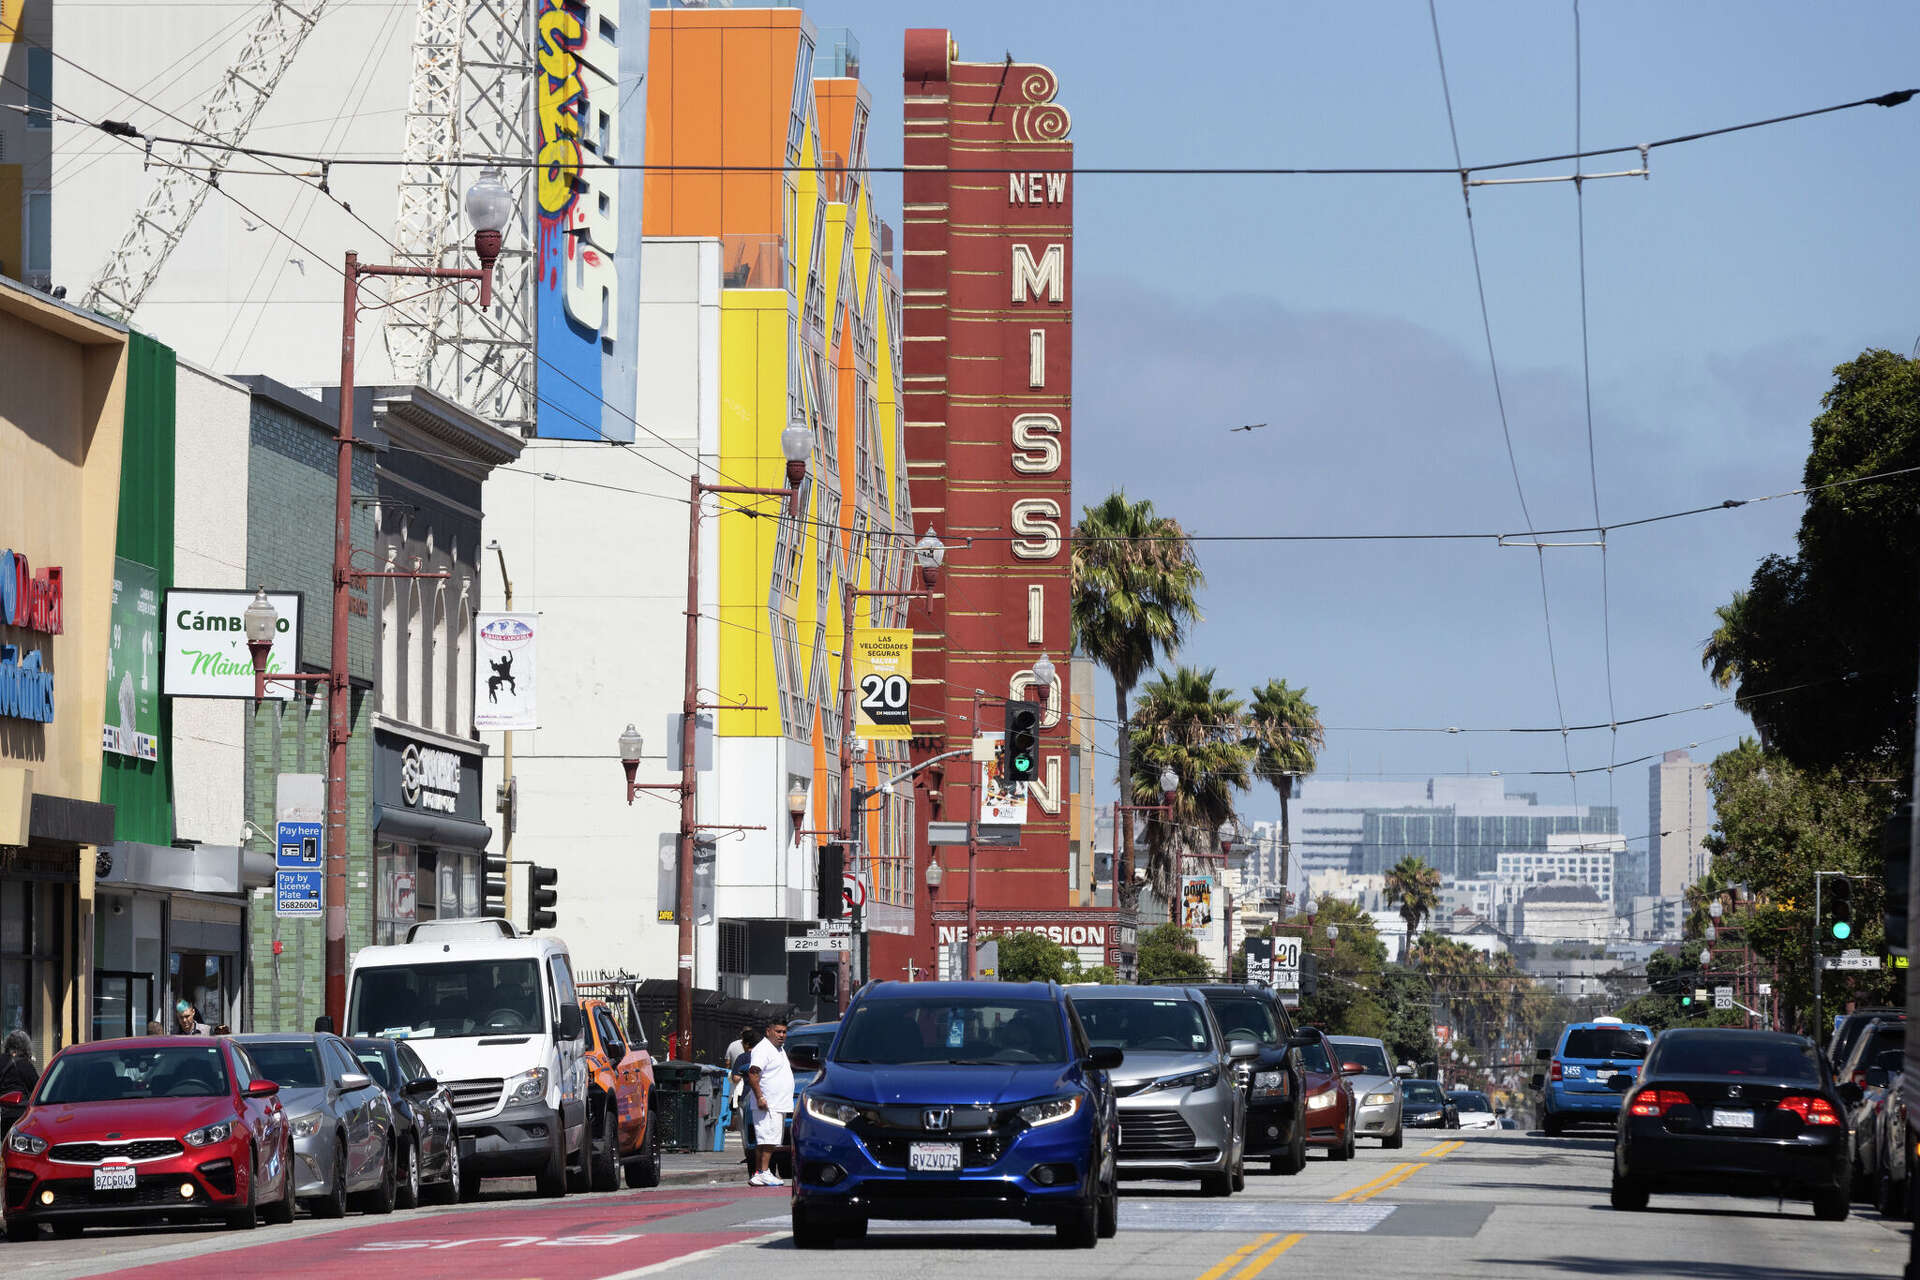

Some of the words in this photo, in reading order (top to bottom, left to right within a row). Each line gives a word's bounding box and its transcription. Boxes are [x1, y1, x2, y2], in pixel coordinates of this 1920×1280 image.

[1009, 172, 1067, 204] NEW
[1009, 243, 1065, 815] MISSION
[859, 642, 909, 650] VELOCIDADES
[181, 648, 282, 677] Mándlo
[861, 674, 908, 708] 20
[280, 826, 297, 837] Pay
[298, 826, 320, 836] here
[279, 874, 294, 883] Pay
[297, 874, 308, 882] by
[279, 882, 311, 891] License
[279, 891, 302, 899] Plate
[280, 901, 318, 909] 56826004
[794, 940, 819, 949] 22nd
[830, 940, 842, 949] St
[1278, 943, 1298, 968] 20
[1717, 998, 1731, 1007] 20
[1564, 1066, 1581, 1075] 2455
[912, 1153, 959, 1168] 8VZV075
[358, 1233, 645, 1251] BUS
